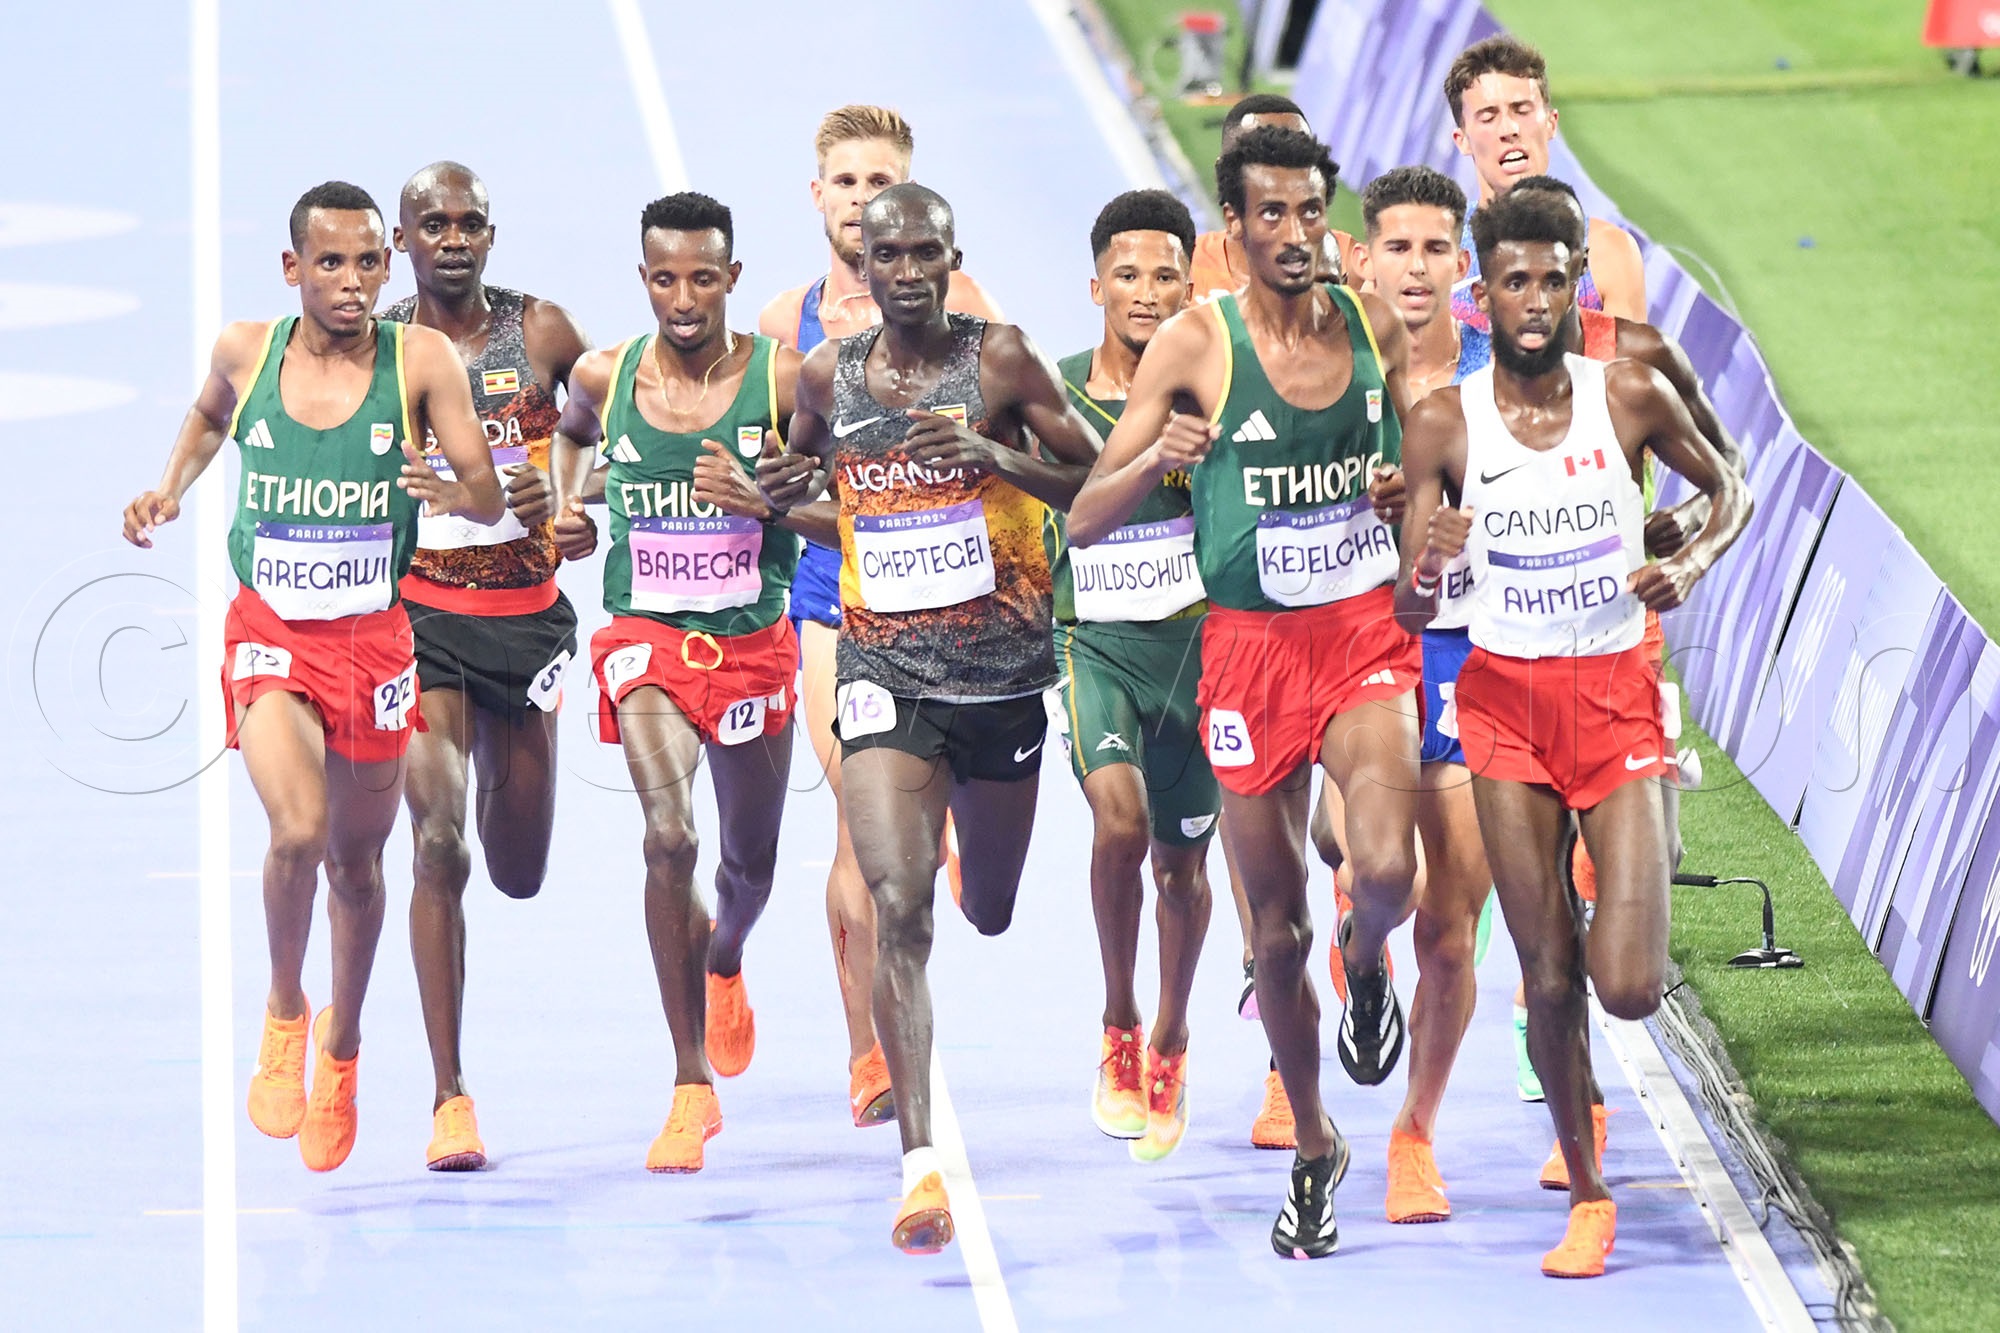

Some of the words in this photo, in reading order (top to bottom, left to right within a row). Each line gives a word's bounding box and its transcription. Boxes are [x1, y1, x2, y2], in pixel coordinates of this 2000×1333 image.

[246, 471, 390, 519] ETHIOPIA
[621, 481, 724, 519] ETHIO
[661, 521, 696, 532] PARIS
[699, 521, 731, 531] 2024
[879, 517, 912, 529] PARIS
[913, 513, 947, 526] 2024
[1292, 513, 1325, 527] PARIS
[1328, 506, 1356, 520] 202
[1484, 499, 1618, 538] CANADA
[288, 528, 324, 539] PARIS
[327, 529, 359, 540] 2024
[1102, 529, 1135, 542] ARIS
[1138, 525, 1170, 539] 2024
[637, 548, 752, 581] BAREGA
[863, 535, 985, 579] CHEPTEGEI
[1262, 525, 1391, 576] KEJELCHA
[1518, 557, 1556, 568] PARIS
[1557, 549, 1591, 565] 2024
[256, 556, 387, 590] AREGAWI
[1075, 551, 1195, 593] WILDSCHUT
[1504, 576, 1619, 615] AHMED
[381, 676, 411, 713] 22
[847, 692, 883, 722] 16
[729, 701, 756, 731] 12
[1212, 724, 1242, 751] 25
